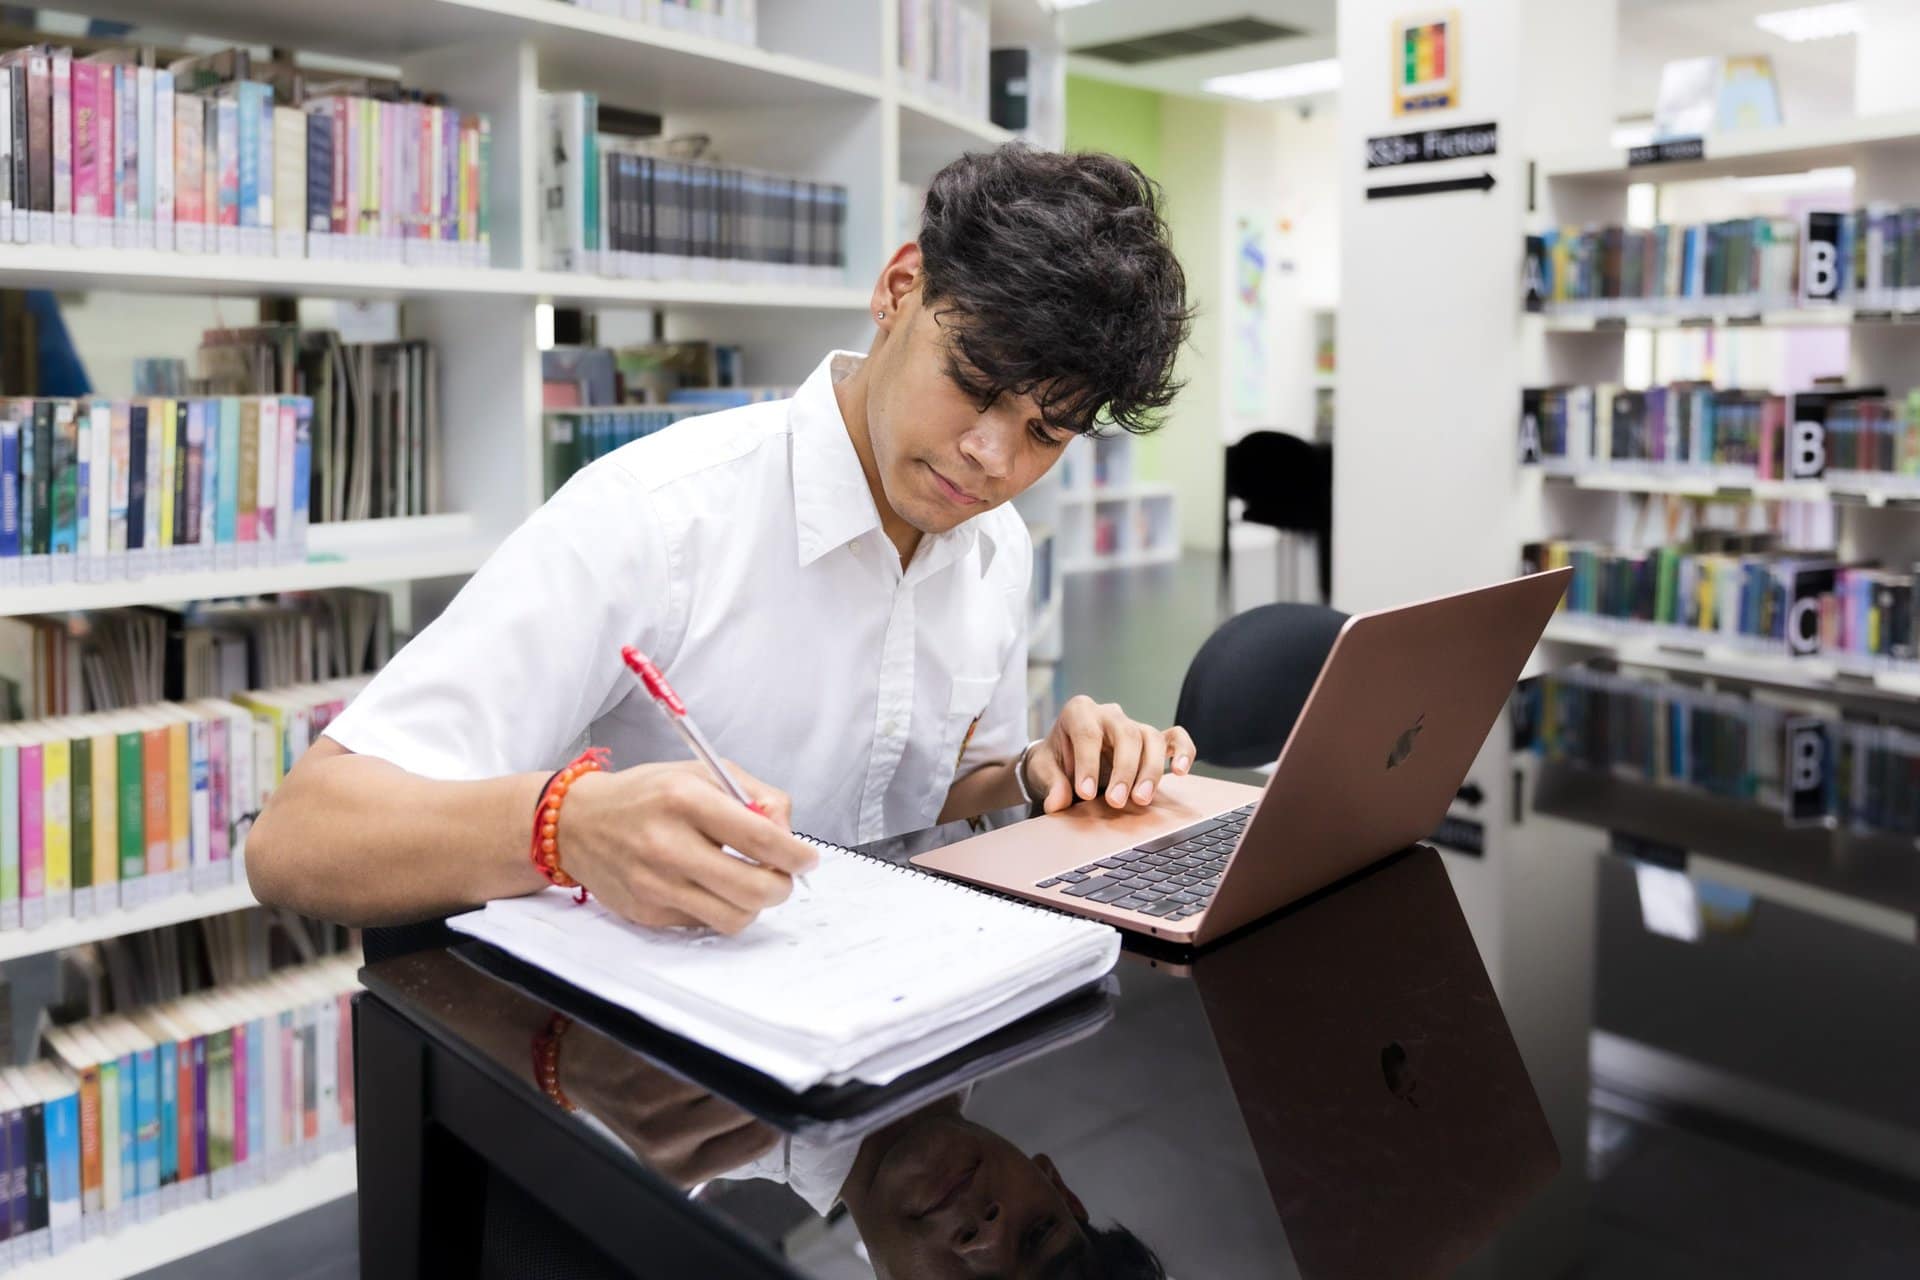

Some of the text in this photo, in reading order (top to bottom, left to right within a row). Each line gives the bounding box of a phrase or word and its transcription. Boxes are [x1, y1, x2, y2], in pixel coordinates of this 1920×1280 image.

[1807, 241, 1837, 296] B
[1792, 421, 1825, 476] B
[1788, 597, 1820, 653] C
